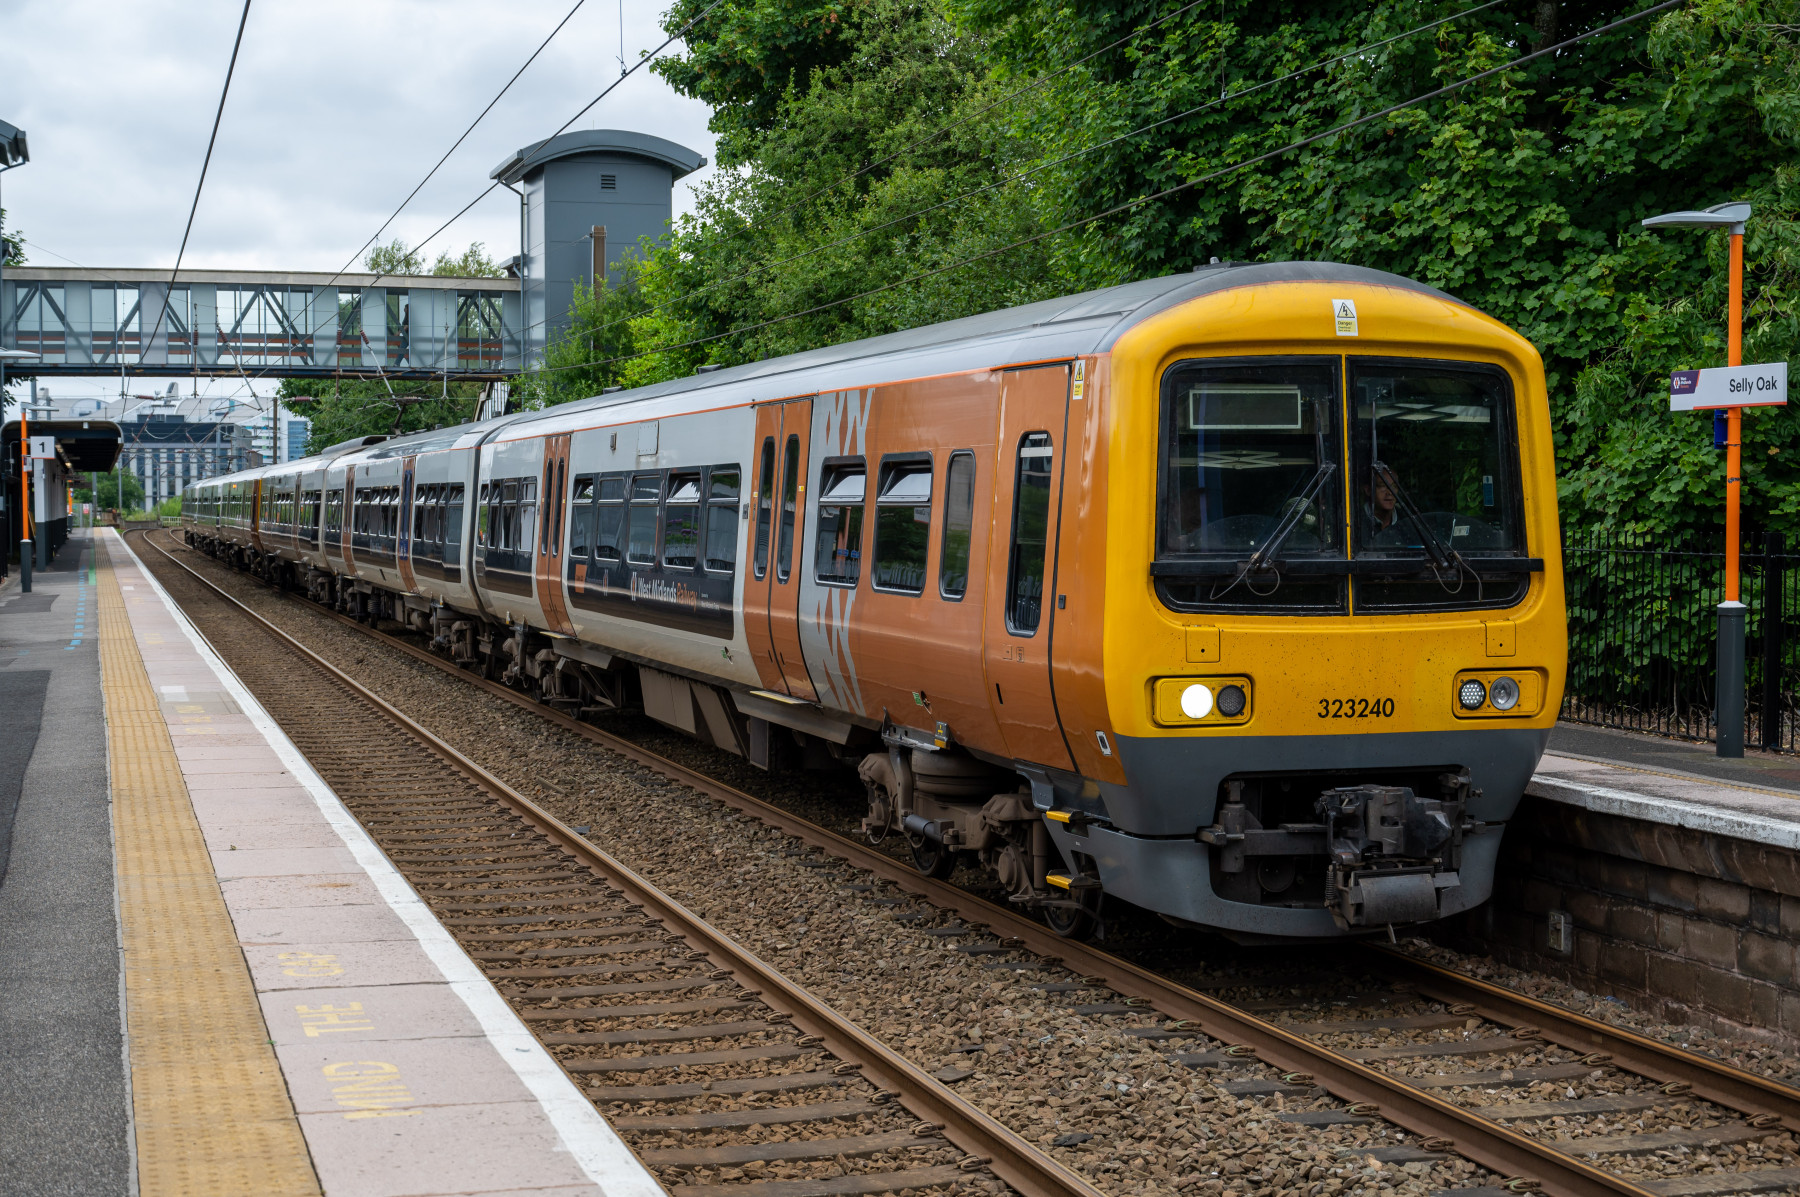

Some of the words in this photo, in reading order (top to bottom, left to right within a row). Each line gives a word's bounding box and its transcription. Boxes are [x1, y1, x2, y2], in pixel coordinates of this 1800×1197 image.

[1729, 378, 1754, 395] Selly
[1756, 376, 1778, 392] Oak
[39, 442, 45, 453] 1
[638, 577, 651, 598] West
[651, 579, 677, 603] Midlands
[676, 582, 698, 613] Railway
[1317, 698, 1395, 718] 323240
[277, 951, 345, 977] GAP
[295, 1001, 375, 1037] THE
[322, 1061, 423, 1119] MIND
